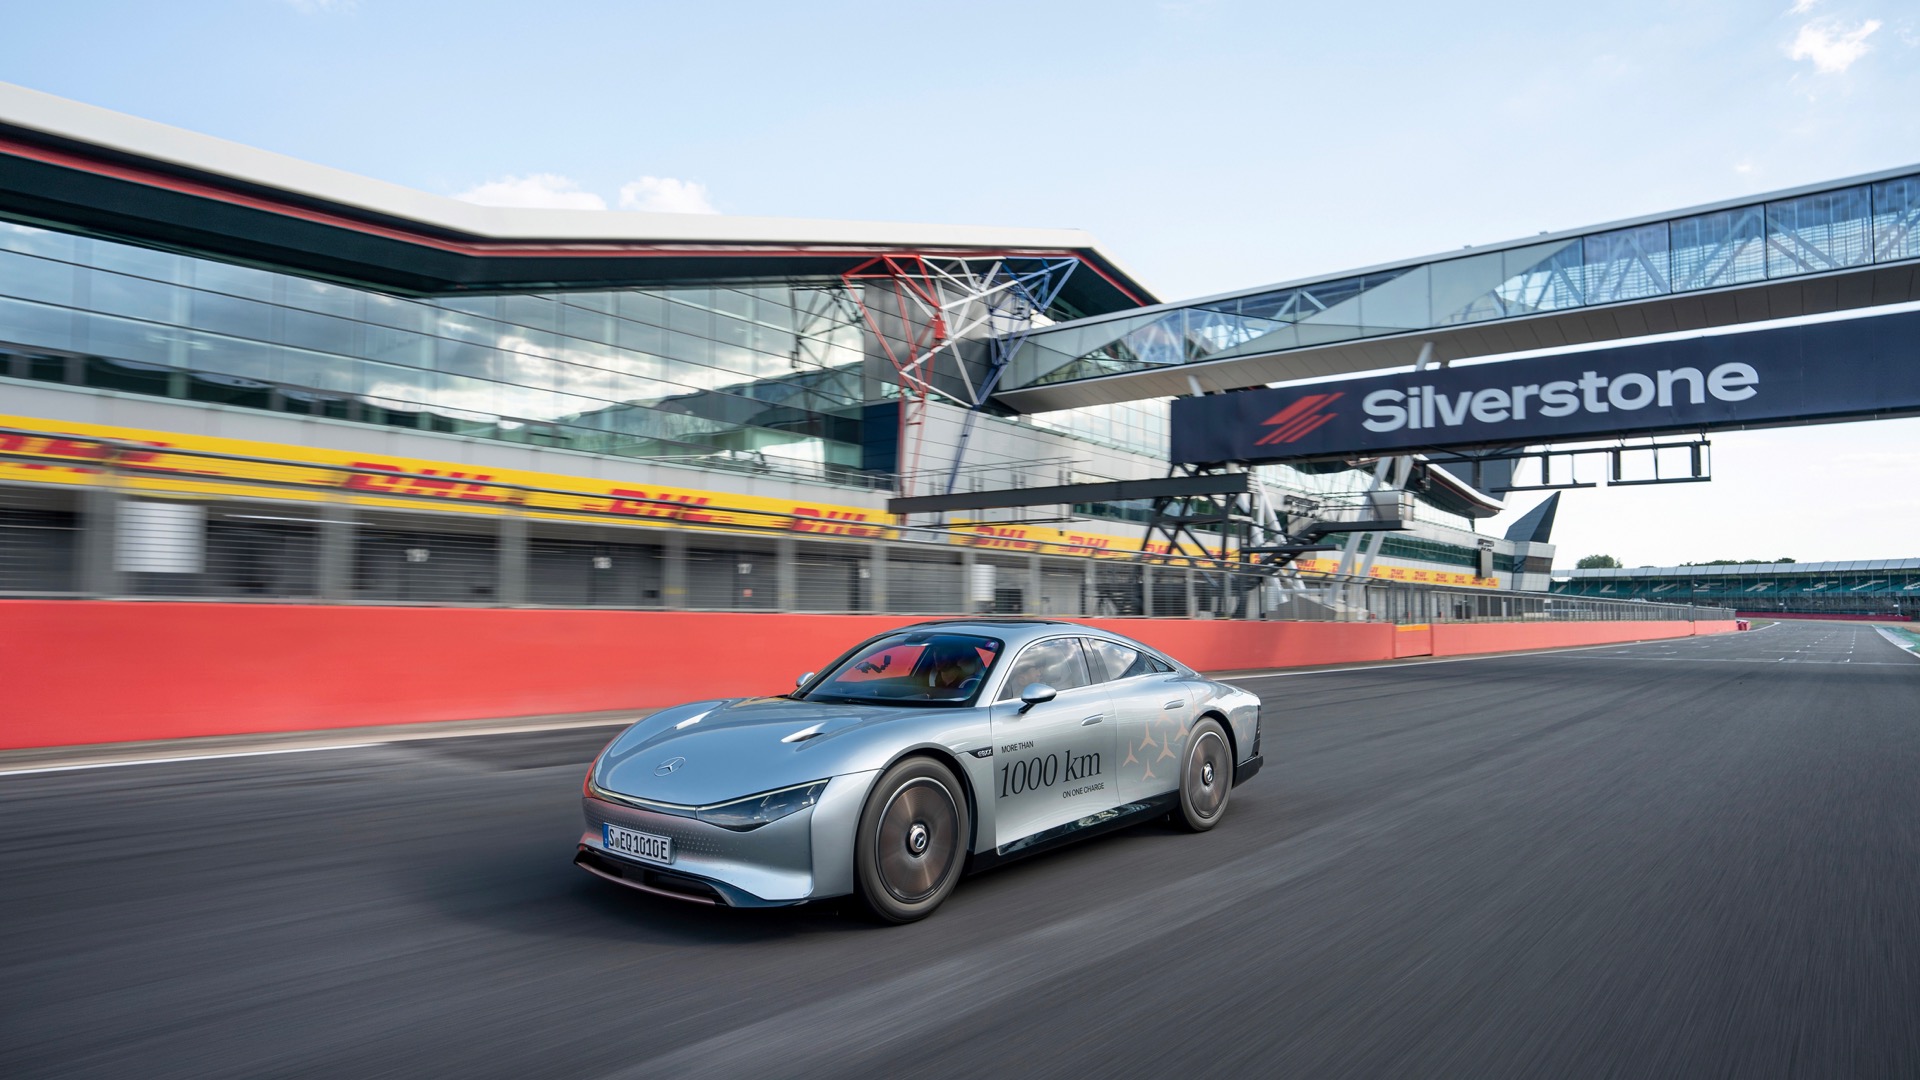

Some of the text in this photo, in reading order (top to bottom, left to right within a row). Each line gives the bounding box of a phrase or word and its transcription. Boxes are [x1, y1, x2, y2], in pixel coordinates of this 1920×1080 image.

[1361, 362, 1760, 433] Silverstone
[343, 462, 497, 501] DHL
[609, 489, 712, 522] DHL
[791, 507, 868, 537] DHL
[974, 526, 1028, 548] DHL
[1068, 536, 1110, 556] DHL
[1001, 741, 1034, 754] MORE THAN
[1000, 749, 1102, 799] 1000 km
[1062, 782, 1105, 799] ON ONE CHARGE
[609, 829, 615, 847] S
